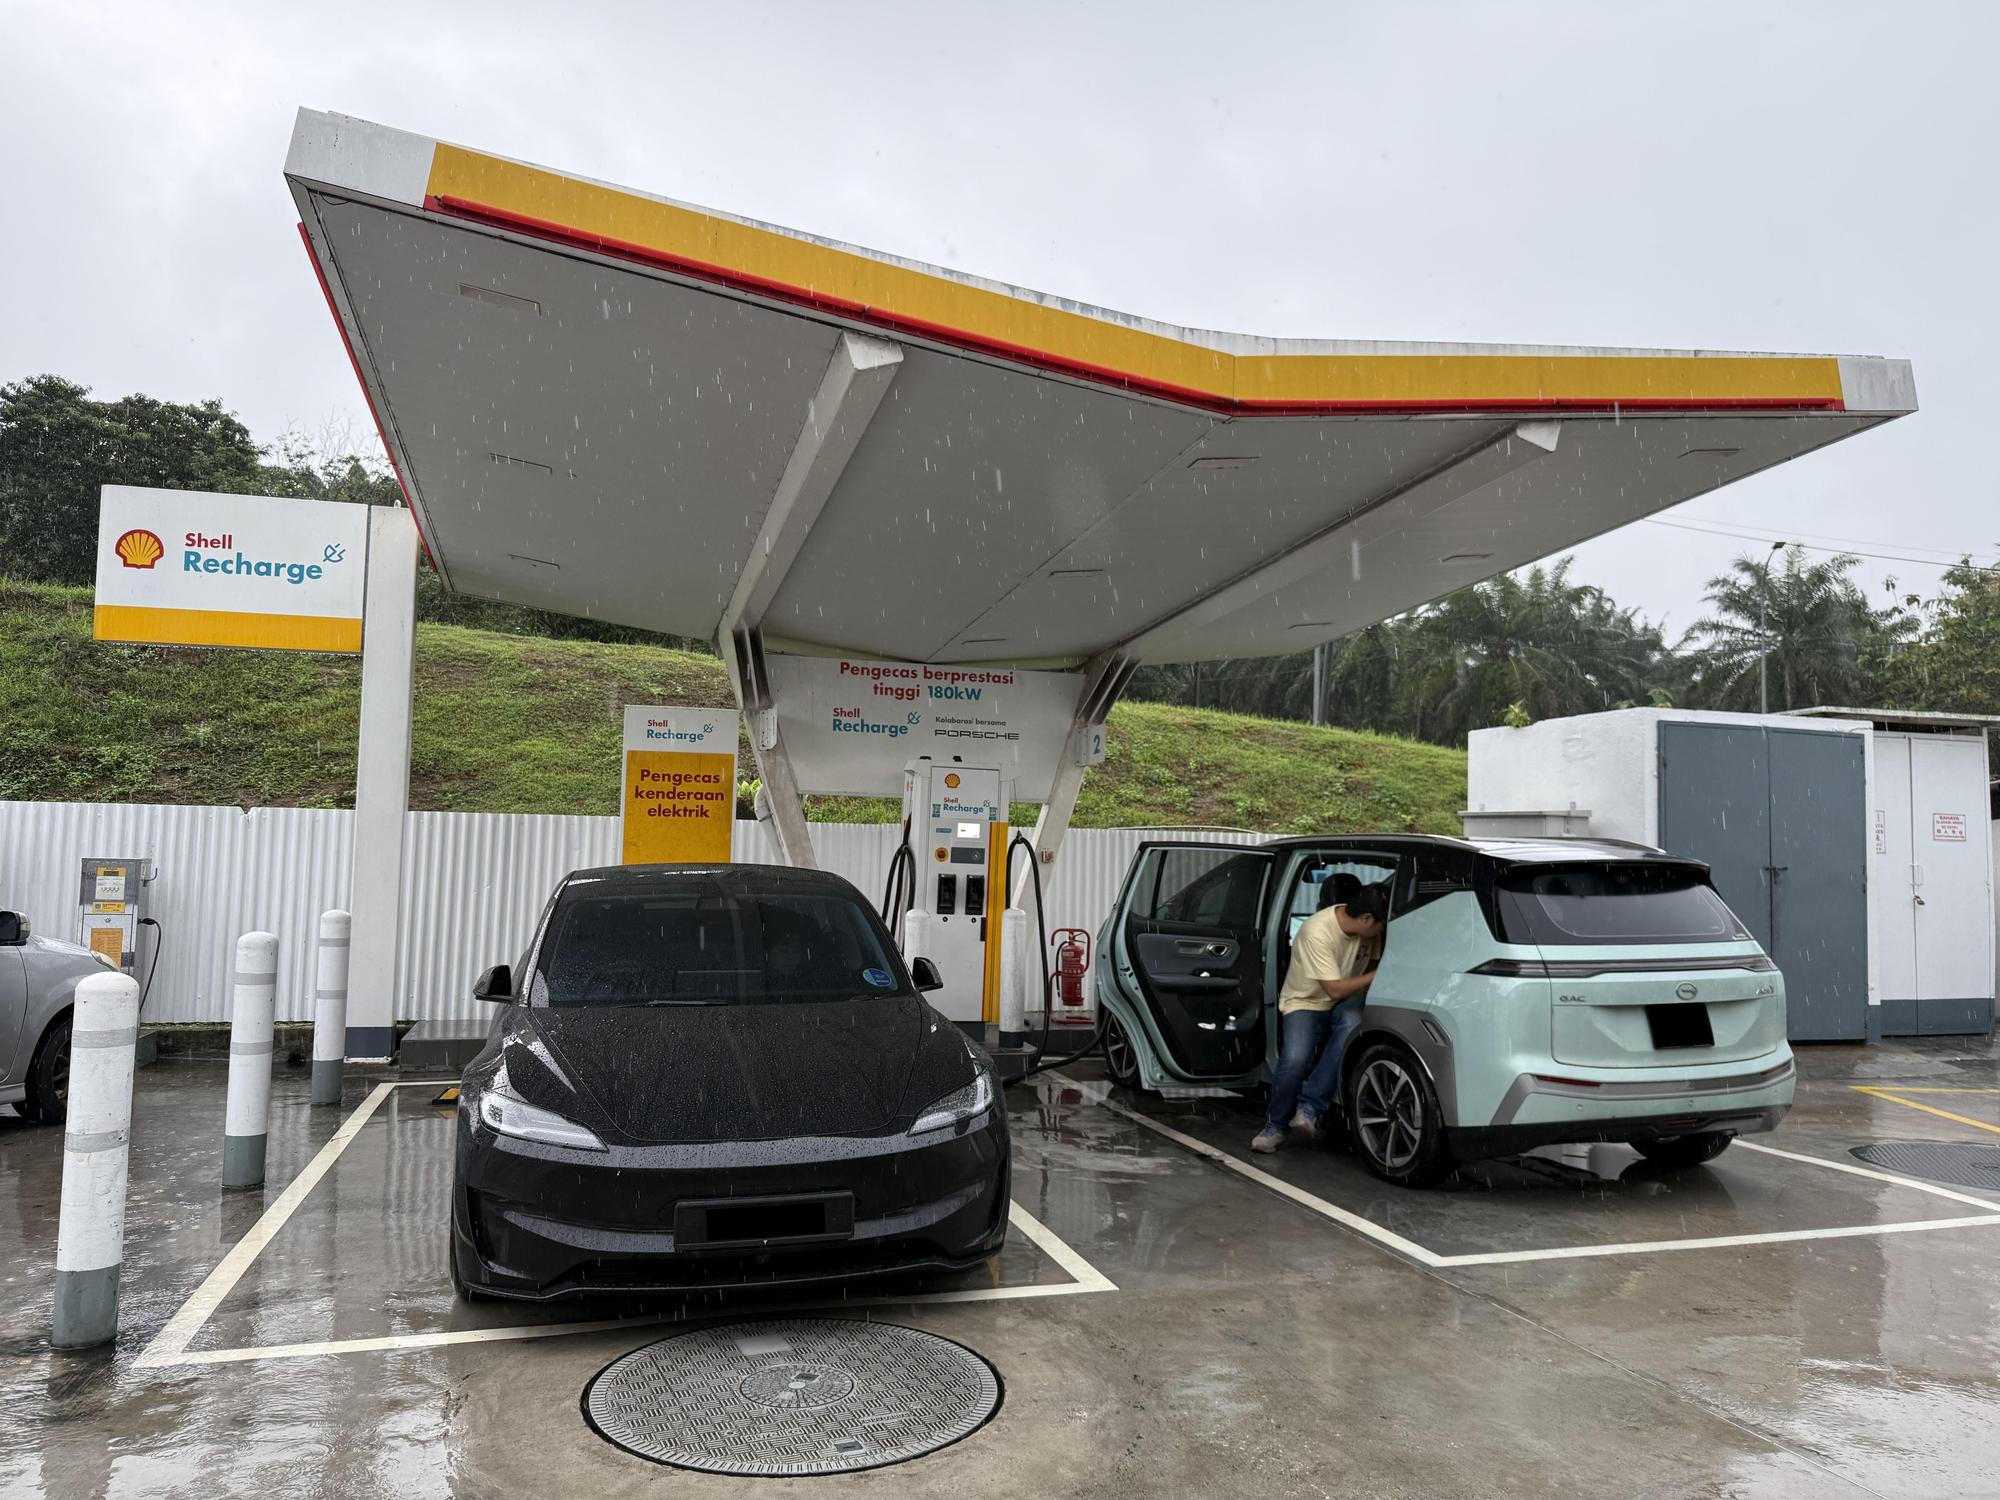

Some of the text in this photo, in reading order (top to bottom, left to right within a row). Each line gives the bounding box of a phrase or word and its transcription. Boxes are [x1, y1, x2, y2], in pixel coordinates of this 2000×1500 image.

[184, 532, 232, 550] Shell
[183, 550, 323, 585] Recharge
[840, 661, 1014, 685] Pengecas berprestasi
[873, 682, 982, 701] tinggi 180kW
[833, 707, 860, 718] Shell
[647, 719, 669, 728] Shell
[832, 718, 908, 738] Recharge
[935, 716, 1007, 727] Kolaborasi bersama
[646, 729, 704, 743] Recharge
[934, 729, 1020, 741] PORSCHE
[1093, 734, 1101, 755] 2
[640, 769, 721, 786] Pengecas
[634, 785, 725, 801] kenderaan
[647, 804, 711, 818] elektrik
[943, 803, 984, 815] Recharge
